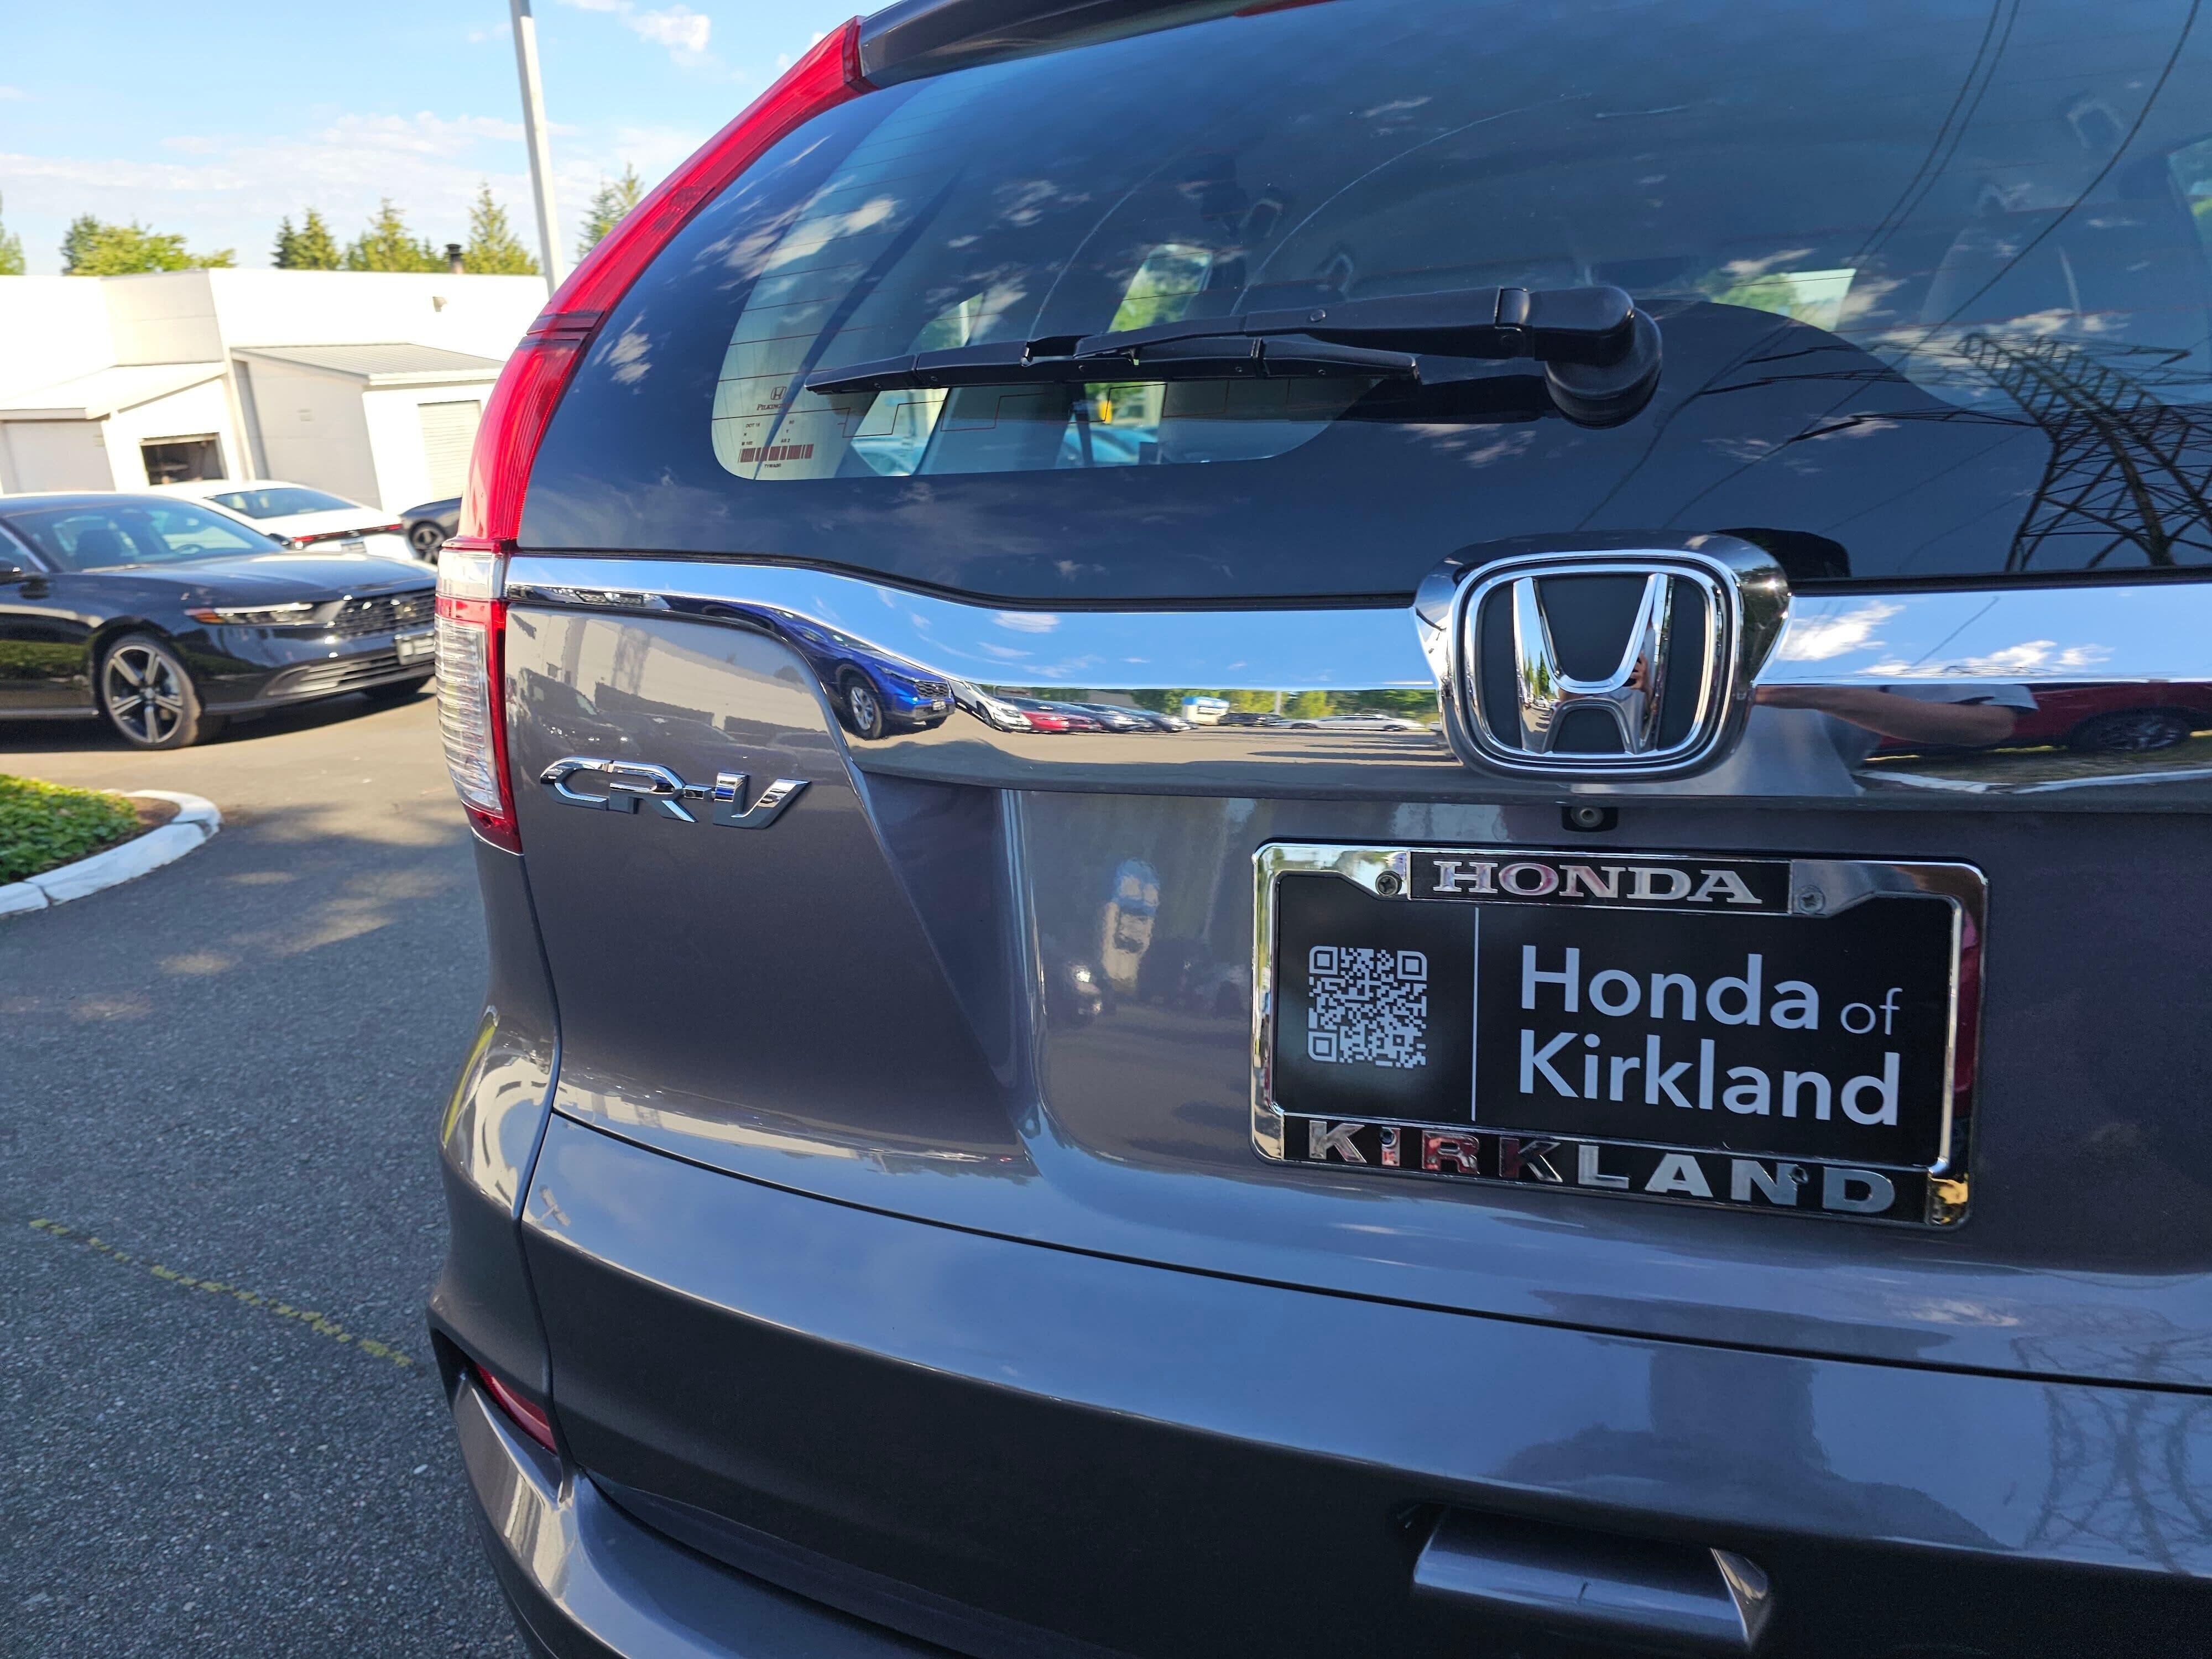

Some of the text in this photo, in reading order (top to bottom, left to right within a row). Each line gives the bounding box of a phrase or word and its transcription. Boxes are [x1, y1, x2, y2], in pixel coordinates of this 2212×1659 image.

[540, 755, 812, 829] CR-V
[1433, 860, 1763, 904] HONDA
[1521, 945, 1903, 1035] Honda of
[1520, 1029, 1900, 1126] Kirkland
[1308, 1120, 1895, 1213] KIRKLAND
